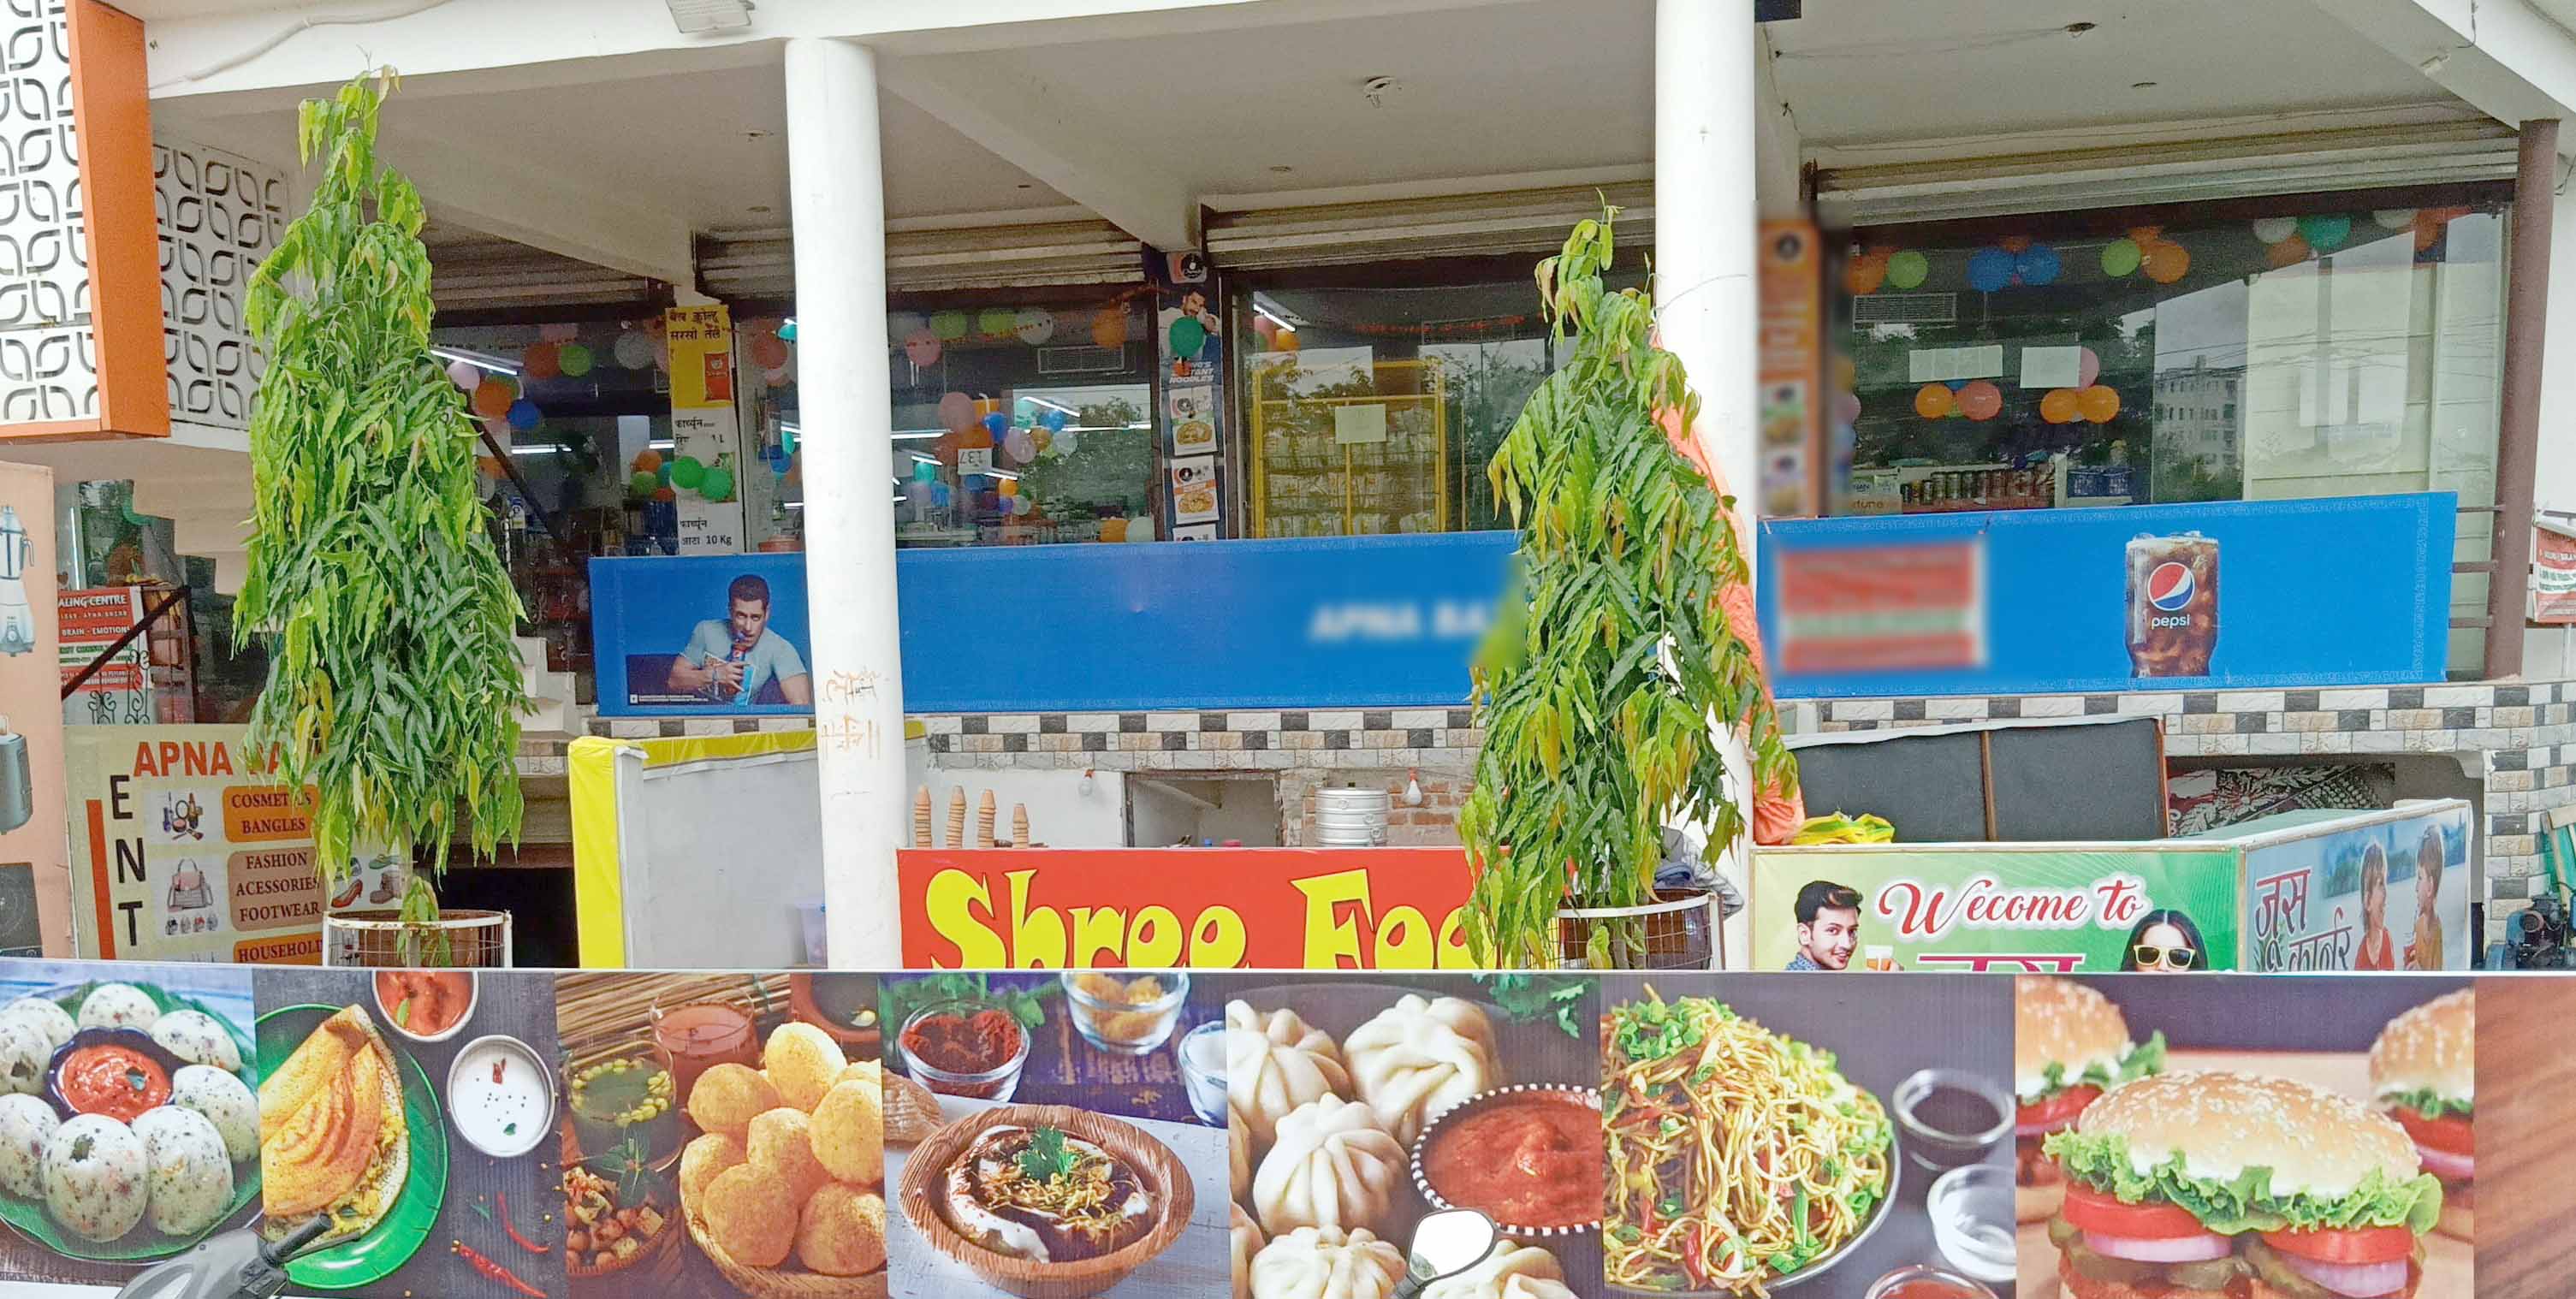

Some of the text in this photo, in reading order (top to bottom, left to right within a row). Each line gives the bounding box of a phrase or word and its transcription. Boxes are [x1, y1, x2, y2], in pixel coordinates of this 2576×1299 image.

[706, 535, 718, 544] 10
[57, 594, 128, 608] ALING CENTRE
[2151, 614, 2191, 630] pepsi
[134, 741, 233, 777] APNA
[232, 791, 312, 809] COSMETS
[241, 817, 306, 835] BANGLES
[246, 851, 308, 870] FASHION
[240, 901, 322, 922] FOOTWEAR
[1879, 879, 2144, 934] Wecome to
[925, 868, 1496, 970] Shree Foo
